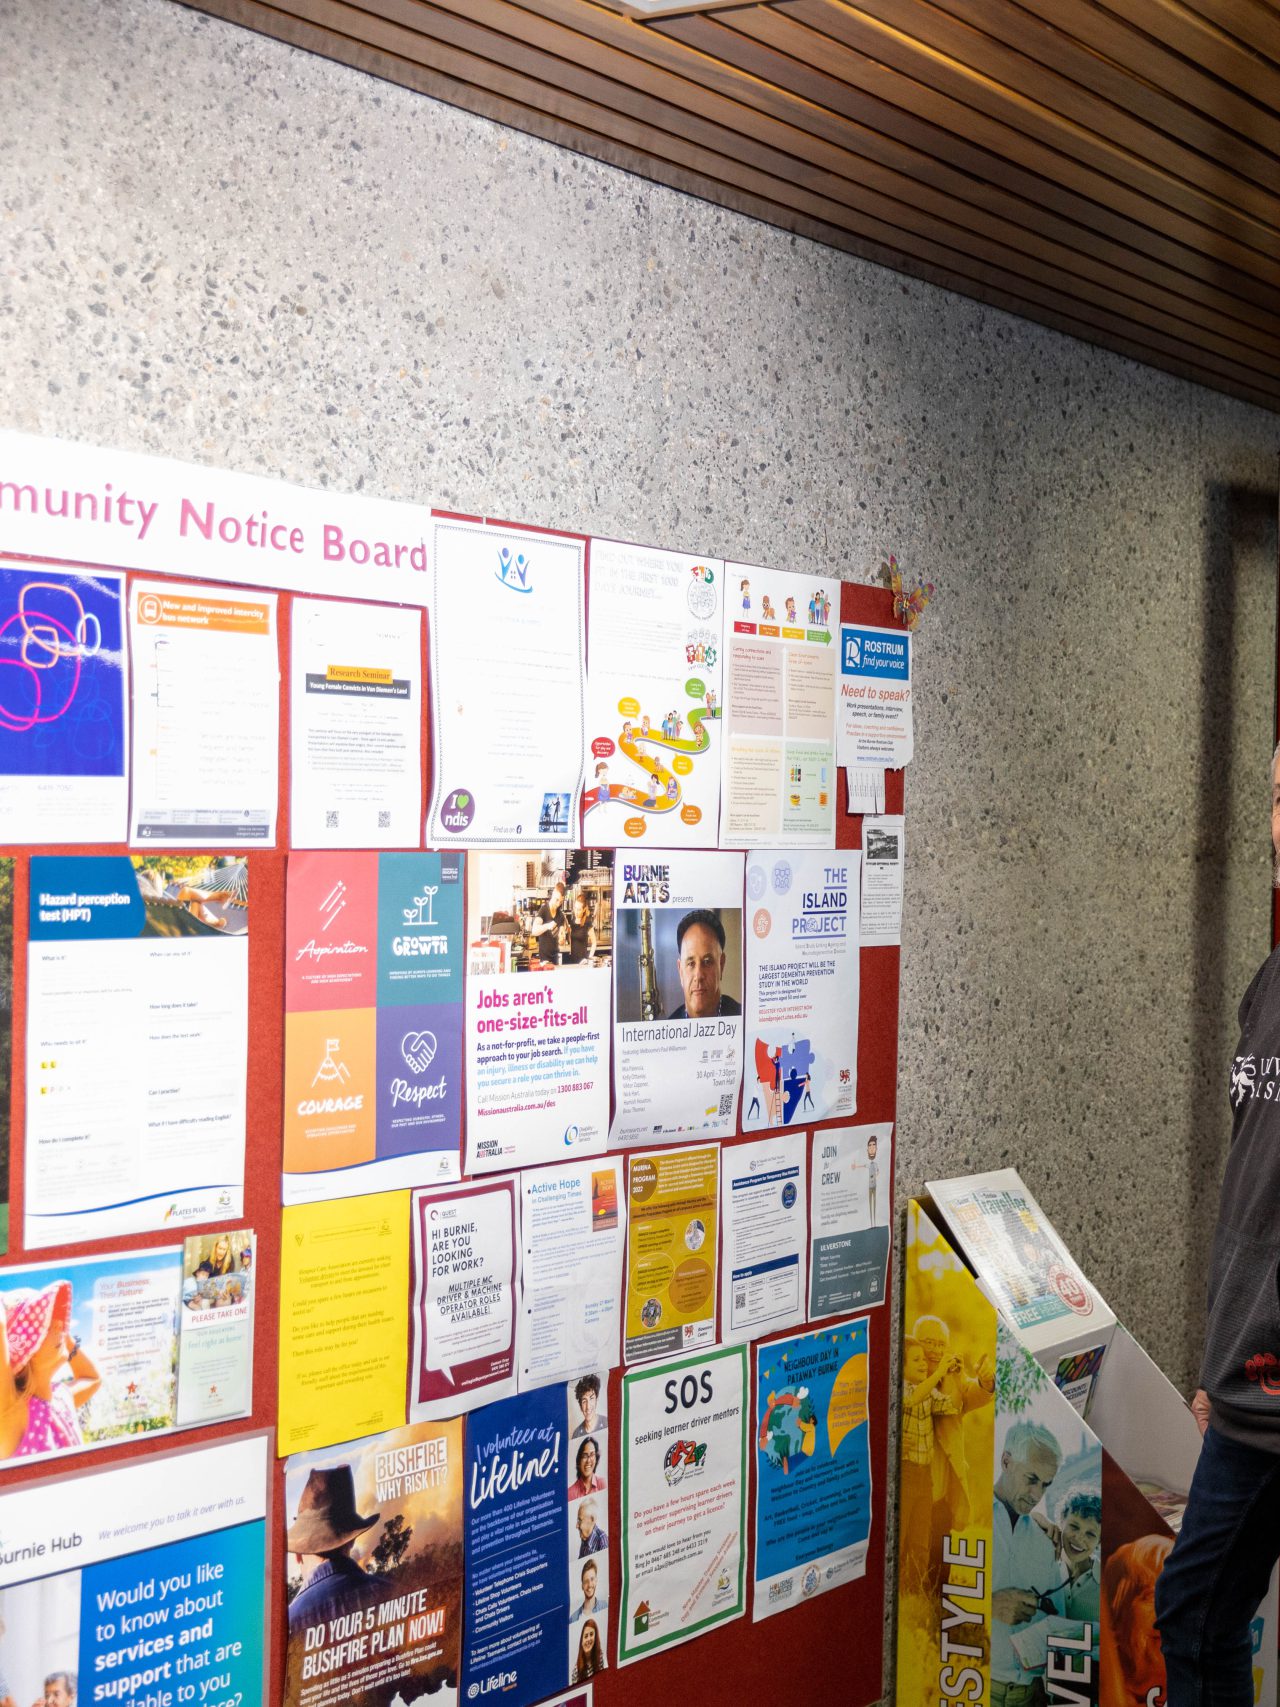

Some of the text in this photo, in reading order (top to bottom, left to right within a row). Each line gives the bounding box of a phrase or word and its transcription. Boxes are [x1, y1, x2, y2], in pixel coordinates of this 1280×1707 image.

[179, 498, 304, 553] Notice
[323, 524, 427, 571] Board
[864, 640, 904, 656] ROSTRUM
[862, 654, 904, 670] find your voice
[330, 668, 390, 680] Research Seminar
[841, 684, 910, 702] Need to speak?
[445, 812, 469, 826] ndis
[623, 864, 669, 882] BURNIE
[824, 868, 847, 883] THE
[40, 892, 130, 907] Hazard perception
[623, 882, 670, 904] ARTS
[802, 893, 847, 908] ISLAND
[40, 908, 91, 923] test (HPT)
[296, 939, 368, 962] Aspiration
[759, 972, 780, 980] LARGEST
[781, 971, 805, 979] DEMENTIA
[477, 989, 509, 1009] Jobs
[477, 1006, 588, 1033] one-size-fits-all
[622, 1021, 737, 1042] International Jazz Day
[477, 1043, 485, 1052] As
[492, 1039, 536, 1050] not-for-profit,
[547, 1036, 560, 1045] take
[566, 1032, 600, 1044] people-first
[390, 1075, 447, 1108] Respect
[557, 1082, 594, 1093] 1300 883 067
[297, 1095, 363, 1115] COURAGE
[477, 1140, 498, 1150] MISSION
[822, 1145, 837, 1159] JOIN
[532, 1179, 580, 1194] Active Hope
[633, 1175, 655, 1183] PROGRAM
[822, 1172, 840, 1186] CREW
[432, 1222, 477, 1239] HI BURNIE,
[432, 1236, 470, 1252] ARE YOU
[820, 1240, 852, 1251] ULVERSTONE
[432, 1248, 473, 1265] LOOKING
[432, 1257, 483, 1277] FOR WORK?
[437, 1283, 502, 1305] DRIVER & MACHINE
[449, 1275, 493, 1293] MULTIPLE MC
[440, 1293, 500, 1315] OPERATOR ROLES
[191, 1307, 247, 1323] PLEASE TAKE ONE
[1013, 1308, 1040, 1324] FREE
[784, 1348, 838, 1372] NEIGHBOUR DAY IN
[788, 1361, 838, 1385] PATAWAY BURNIE
[665, 1370, 713, 1414] SOS
[635, 1407, 739, 1445] seeking learner driver mentors
[477, 1422, 555, 1465] I volunteer at
[377, 1440, 445, 1480] BUSHFIRE
[470, 1431, 560, 1509] Lifeline!
[377, 1466, 448, 1503] WHY RISK IT?
[98, 1495, 246, 1540] We welcome you to talk it over with us.
[51, 1532, 82, 1553] Hub
[97, 1562, 224, 1612] Would you like
[95, 1589, 223, 1642] to know about
[305, 1588, 428, 1651] DO YOUR 5 MINUTE
[939, 1535, 986, 1707] STYLE
[94, 1618, 213, 1672] services and
[303, 1609, 445, 1680] BUSHFIRE PLAN NOW!
[93, 1641, 242, 1701] support that are
[178, 1684, 195, 1702] to
[200, 1672, 231, 1701] you
[480, 1671, 517, 1694] Lifeline
